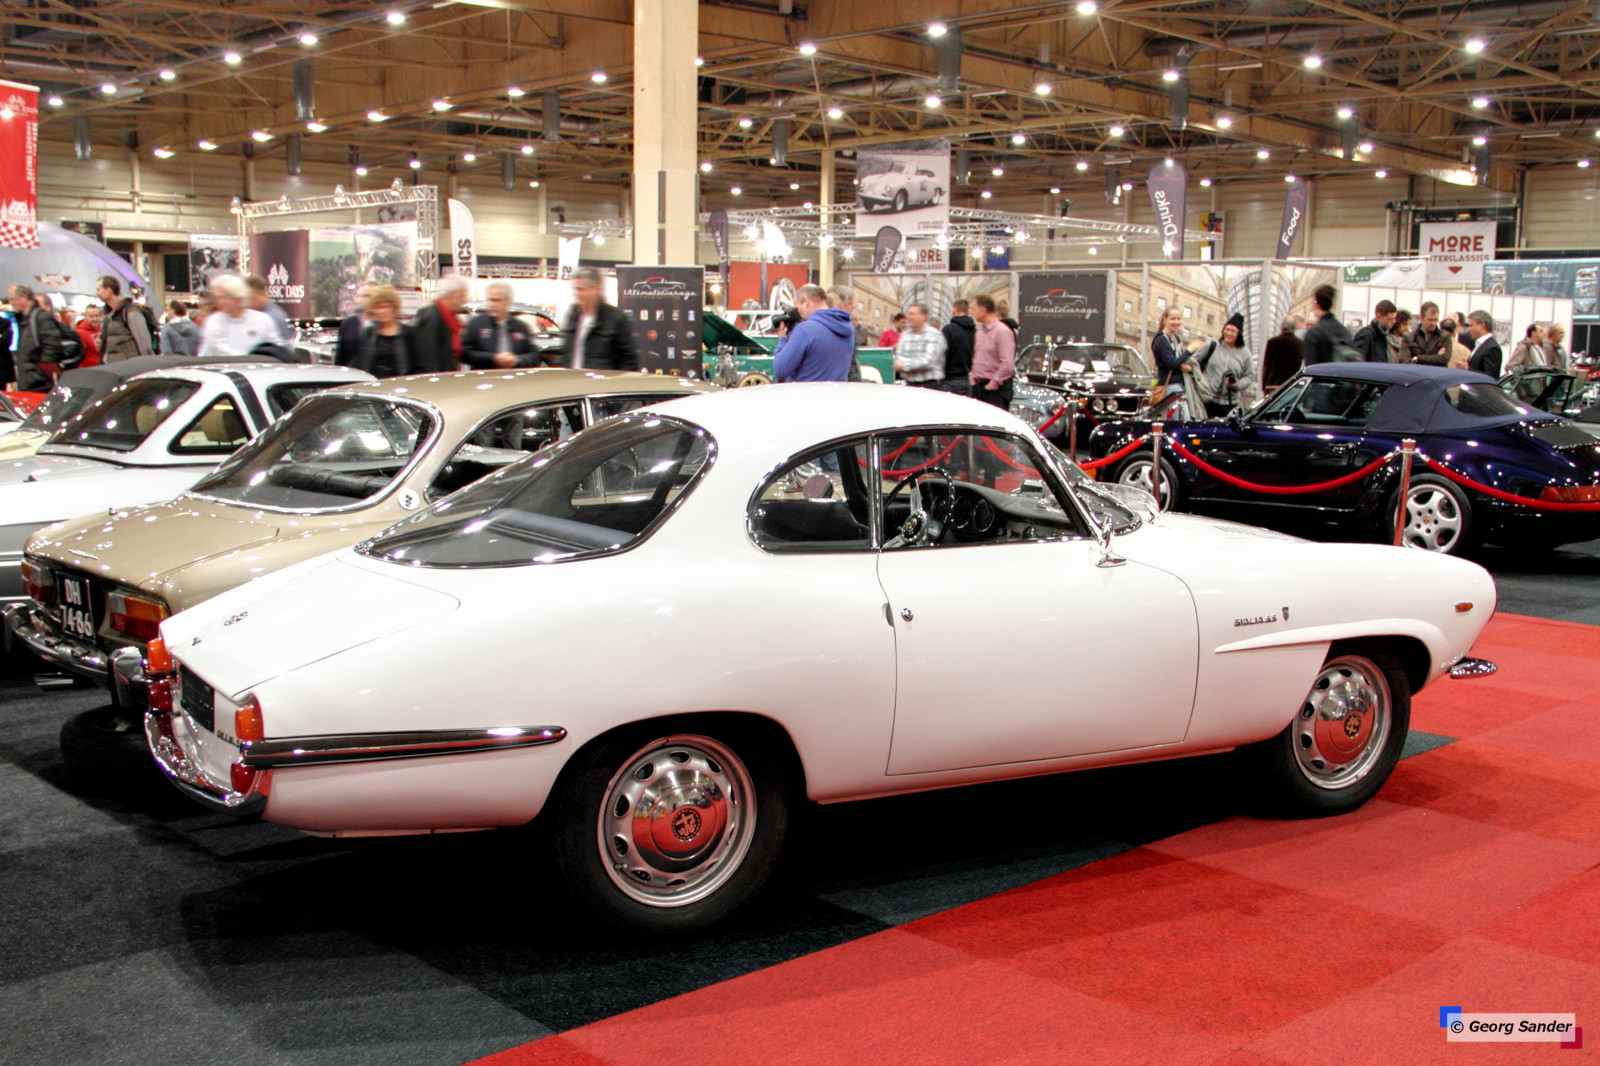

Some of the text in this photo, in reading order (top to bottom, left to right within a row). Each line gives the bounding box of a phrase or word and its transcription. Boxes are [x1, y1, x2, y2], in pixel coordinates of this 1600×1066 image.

[1281, 206, 1301, 247] Food
[1428, 235, 1485, 253] MORE
[908, 249, 943, 263] ORE
[264, 285, 305, 299] ASSIC DAYS
[64, 578, 82, 606] DH
